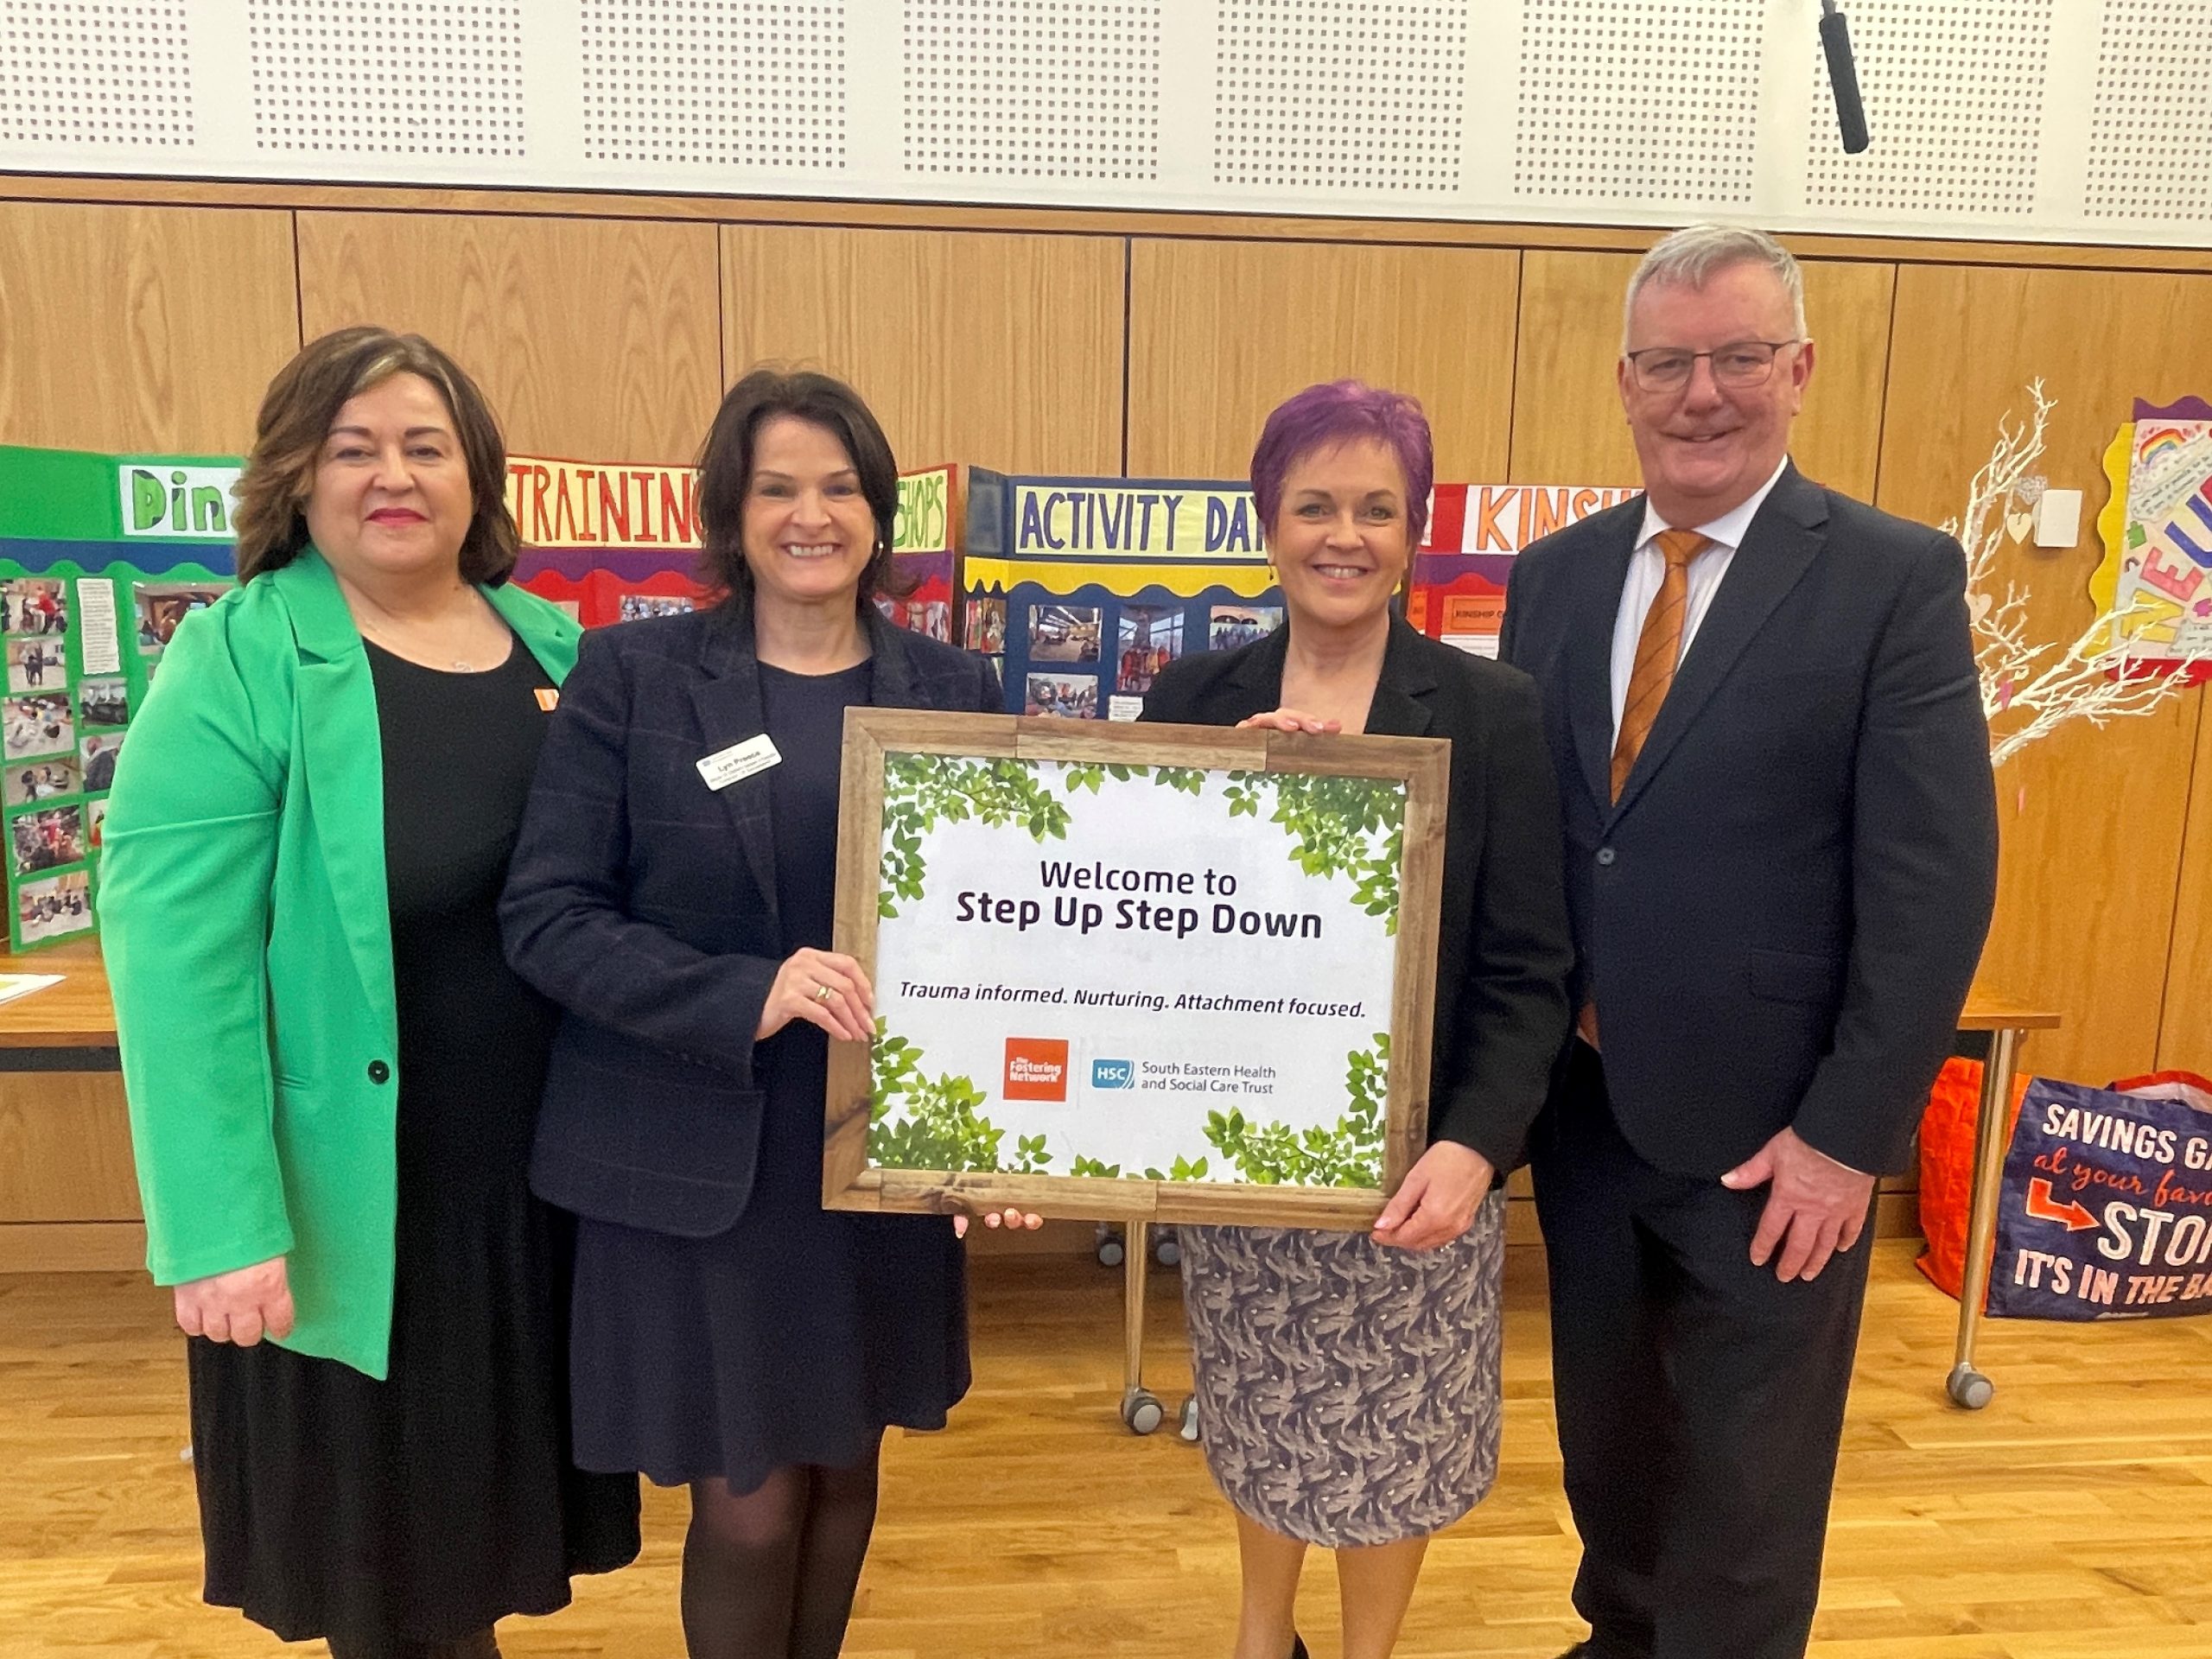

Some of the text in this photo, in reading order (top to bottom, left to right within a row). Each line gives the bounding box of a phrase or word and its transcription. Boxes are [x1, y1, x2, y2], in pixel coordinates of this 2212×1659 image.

[1019, 491, 1185, 551] ACTIVITY
[1039, 861, 1236, 896] Welcome to
[957, 892, 1322, 938] Step Up Step Down
[900, 982, 1366, 1018] Trauma informed. Nurturing. Attachment focused.
[1009, 1060, 1062, 1075] Fostering
[1009, 1071, 1058, 1083] Network
[1097, 1067, 1127, 1080] HSC
[1141, 1061, 1276, 1078] South Eastern Health
[1141, 1078, 1273, 1094] and Social Care Trust
[2043, 1103, 2178, 1164] SAVINGS
[2034, 1147, 2068, 1173] at
[2071, 1166, 2150, 1197] your
[2014, 1249, 2073, 1294] IT'S
[2077, 1264, 2119, 1305] IN
[2125, 1274, 2185, 1305] THE
